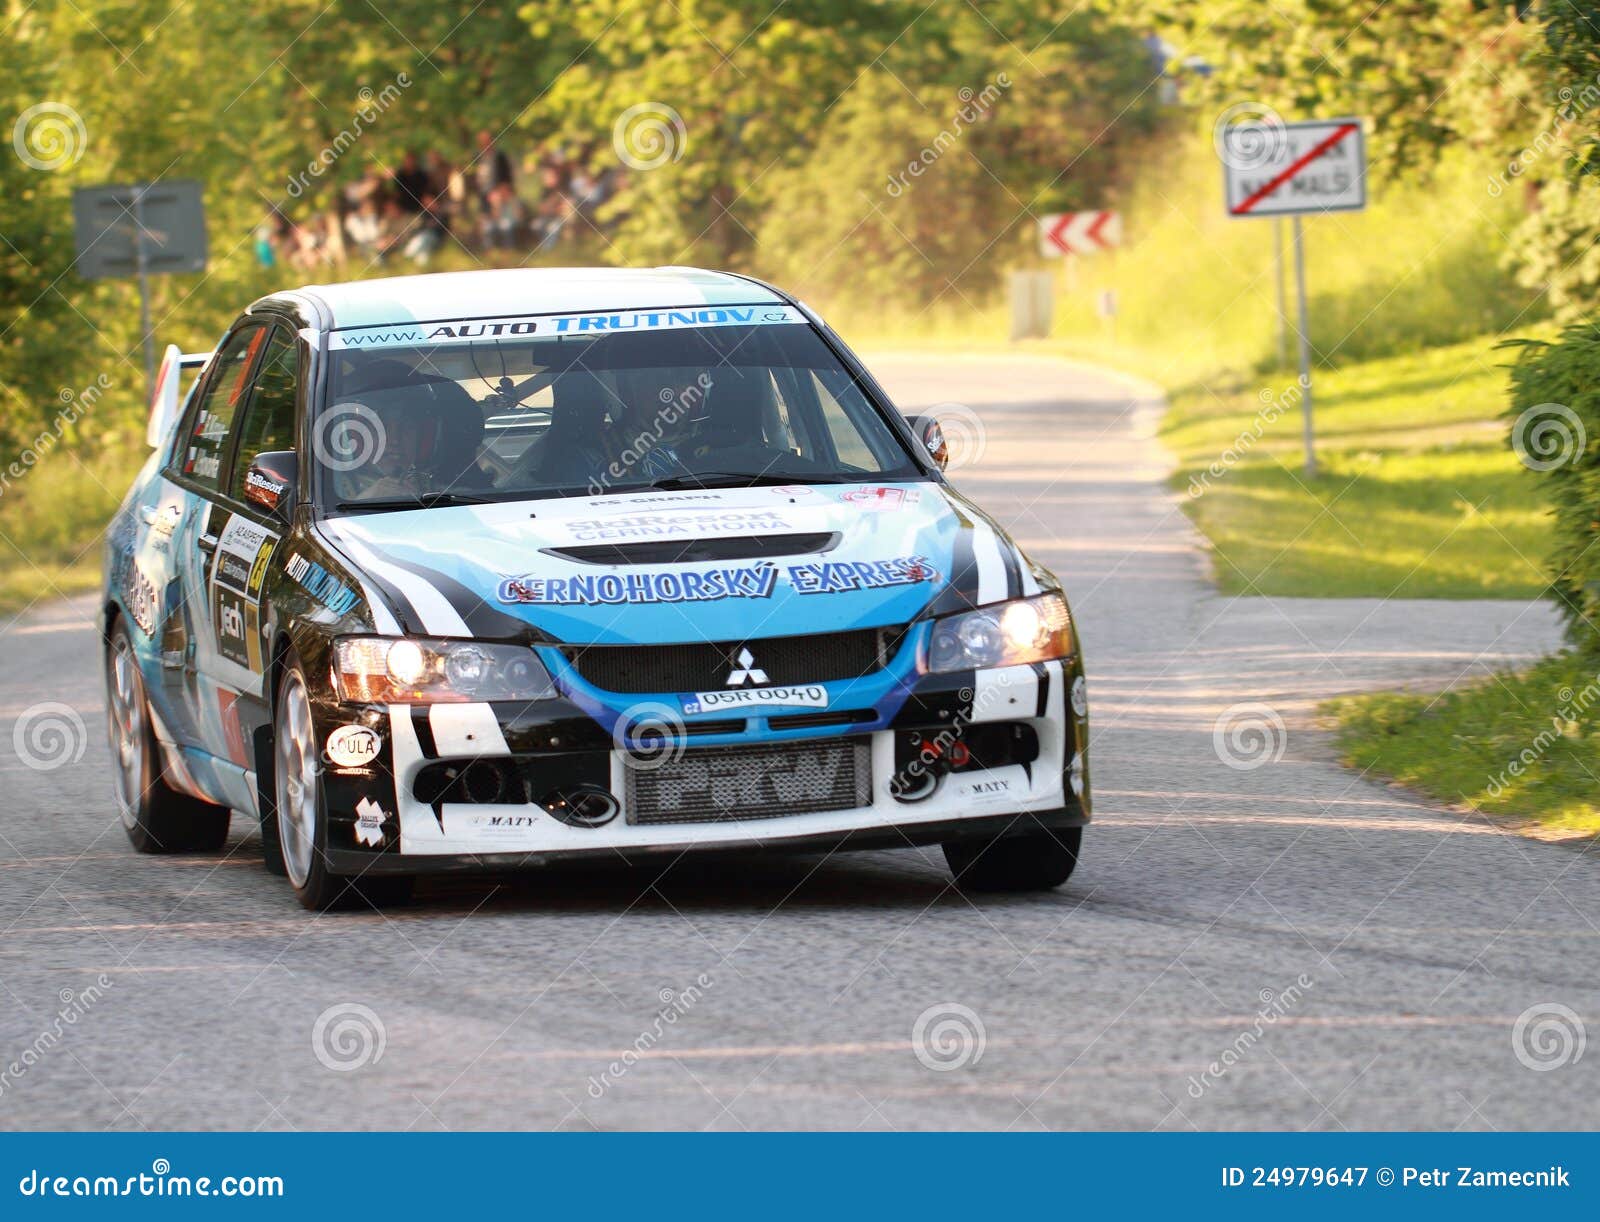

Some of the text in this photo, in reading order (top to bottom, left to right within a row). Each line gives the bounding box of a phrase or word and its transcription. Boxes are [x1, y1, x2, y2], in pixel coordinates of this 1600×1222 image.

[788, 556, 938, 594] EXPRESS
[684, 702, 701, 714] CZ
[487, 816, 539, 827] MATY
